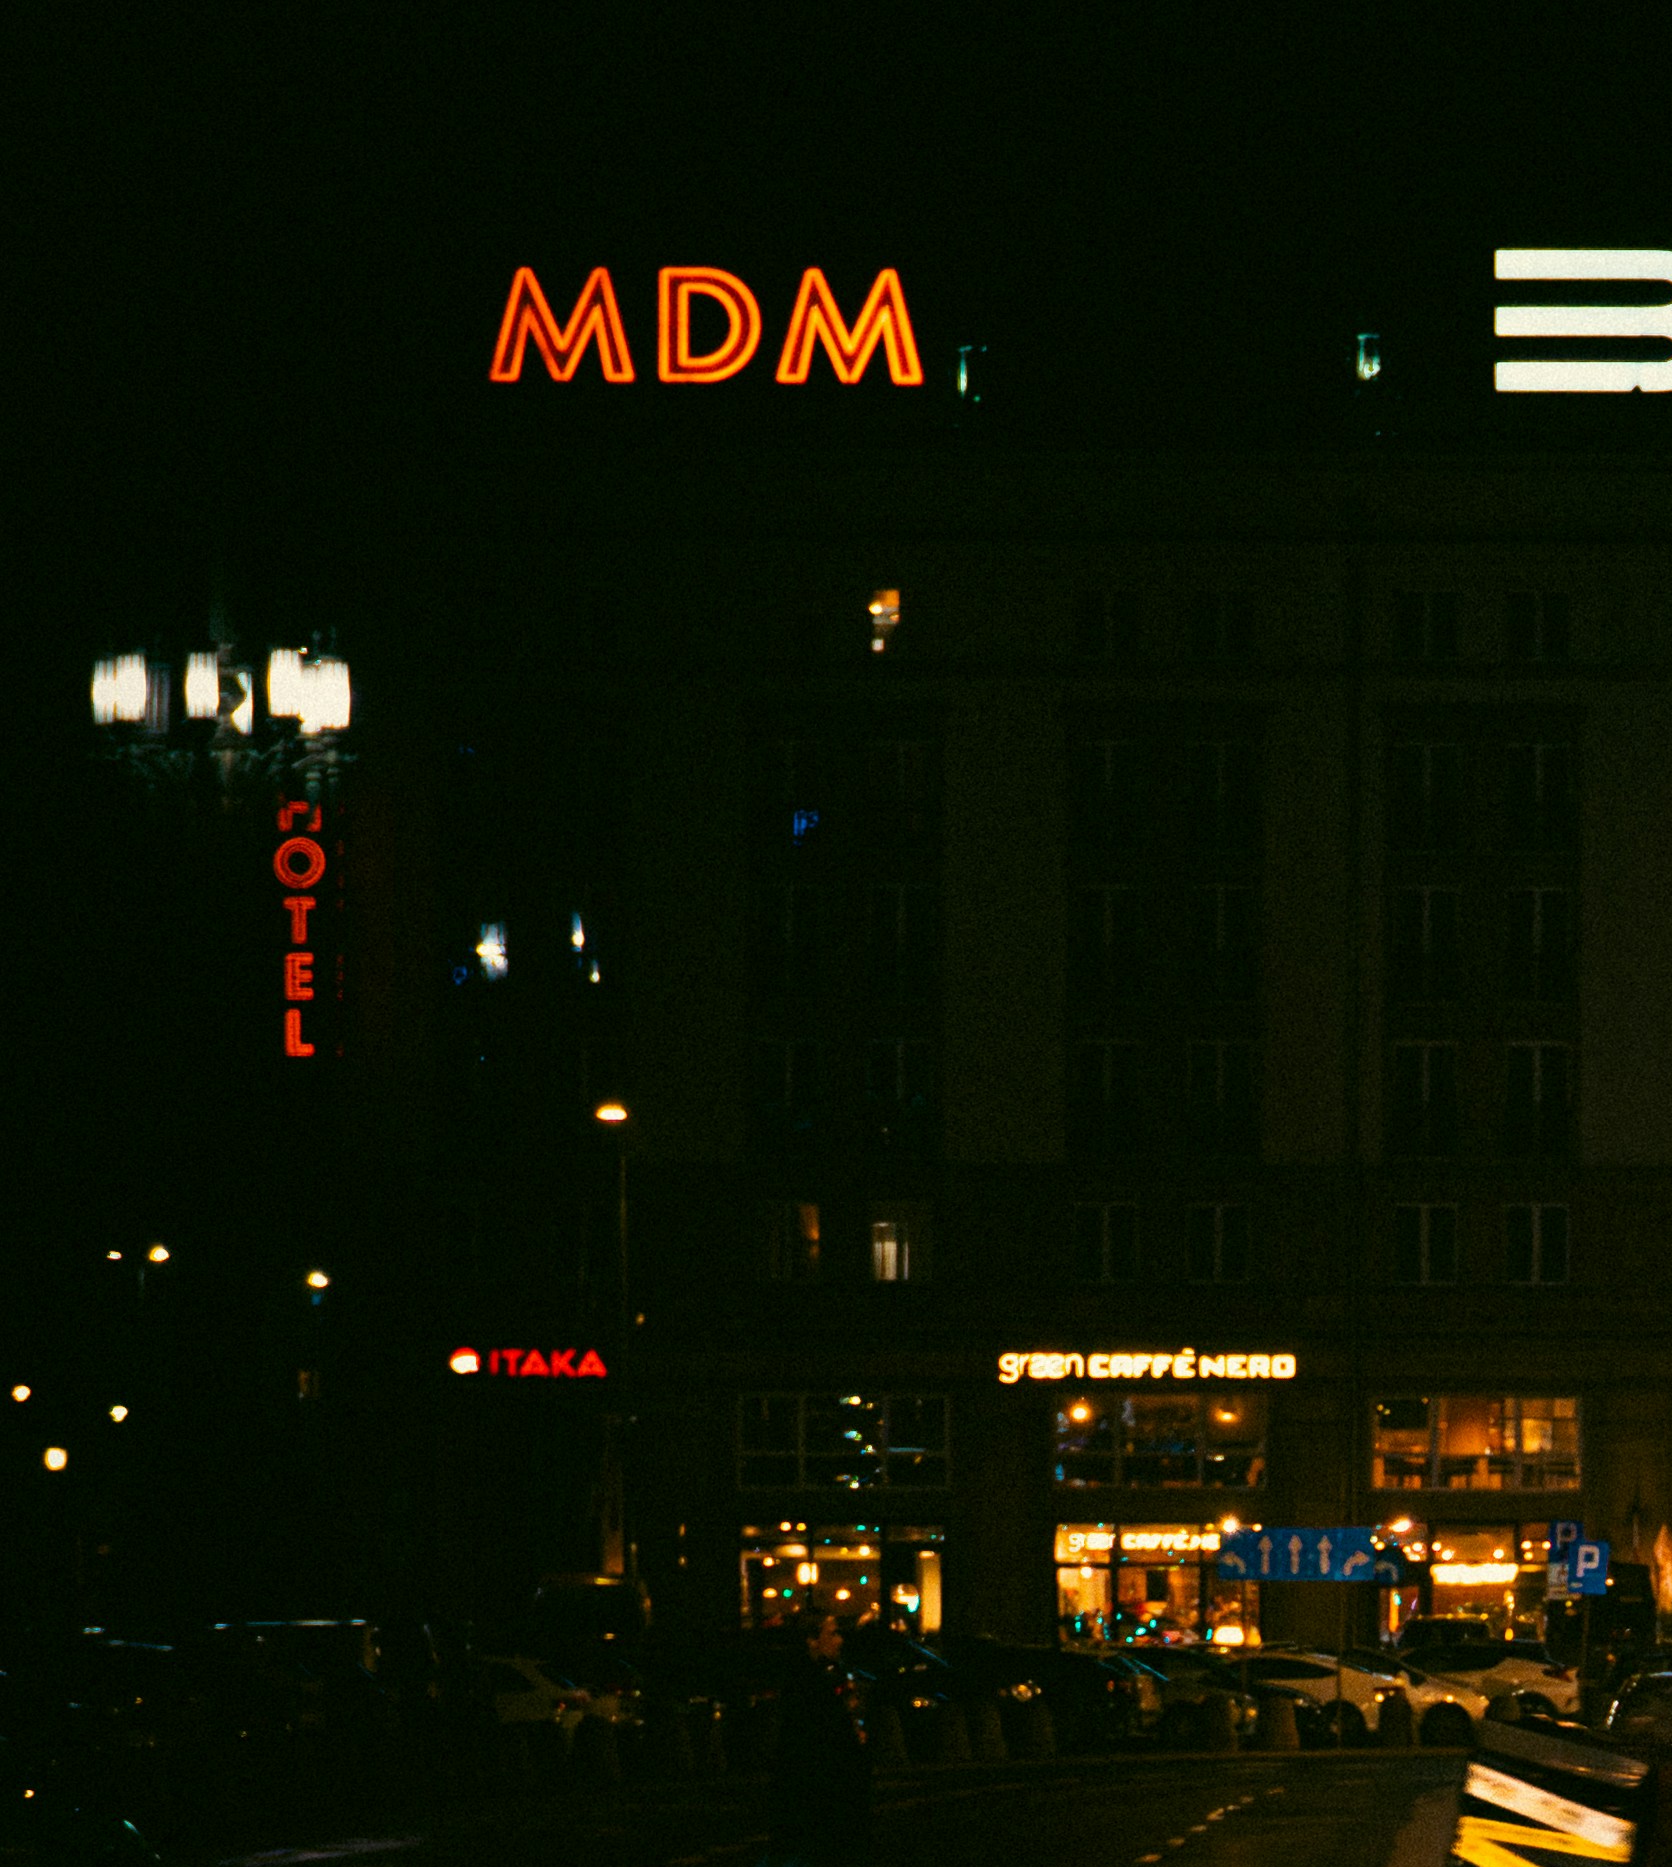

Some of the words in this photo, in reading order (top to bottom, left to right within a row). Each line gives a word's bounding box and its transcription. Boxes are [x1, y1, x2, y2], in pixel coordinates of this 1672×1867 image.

[489, 266, 925, 386] MDM
[489, 1347, 607, 1378] ITAKA
[1198, 1353, 1297, 1379] NERO
[1555, 1521, 1578, 1551] P
[1575, 1544, 1600, 1578] P
